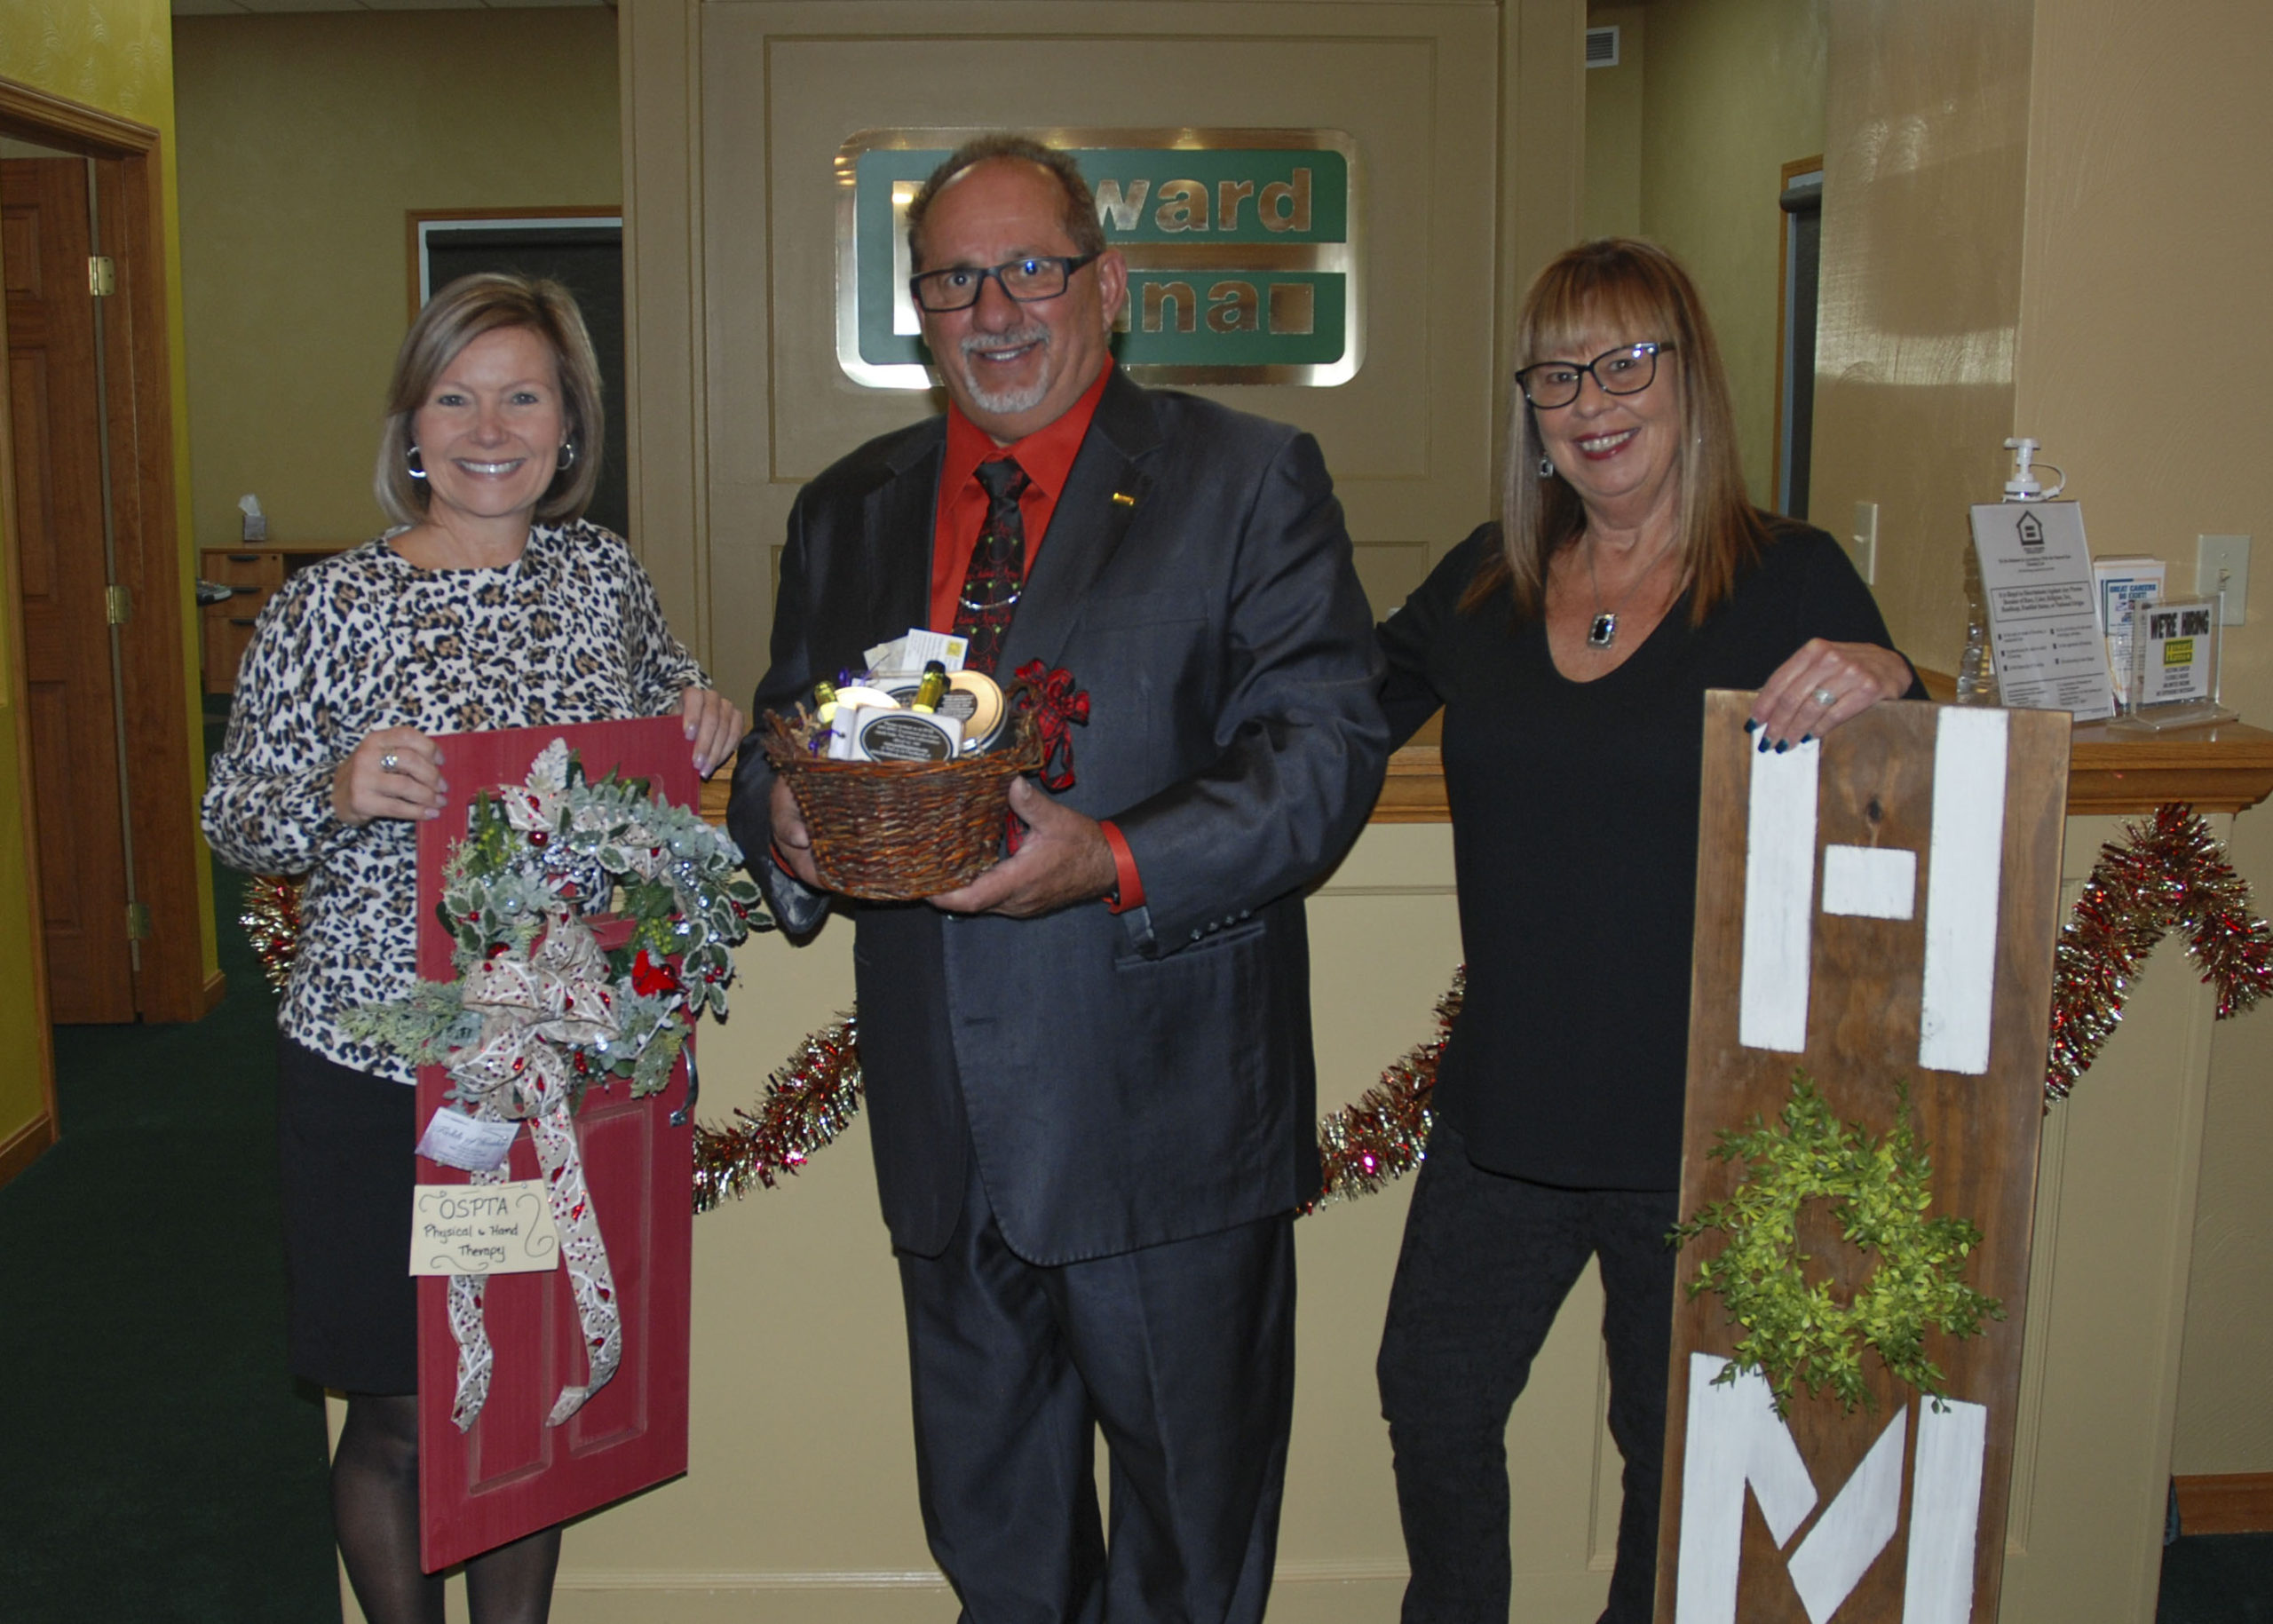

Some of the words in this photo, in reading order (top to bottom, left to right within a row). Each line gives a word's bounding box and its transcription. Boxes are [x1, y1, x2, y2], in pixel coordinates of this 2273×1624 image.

[1096, 168, 1312, 232] ward
[440, 1197, 509, 1219] OSPTA
[424, 1224, 472, 1244] Physical
[490, 1223, 519, 1236] Hand
[458, 1245, 506, 1264] Therapy
